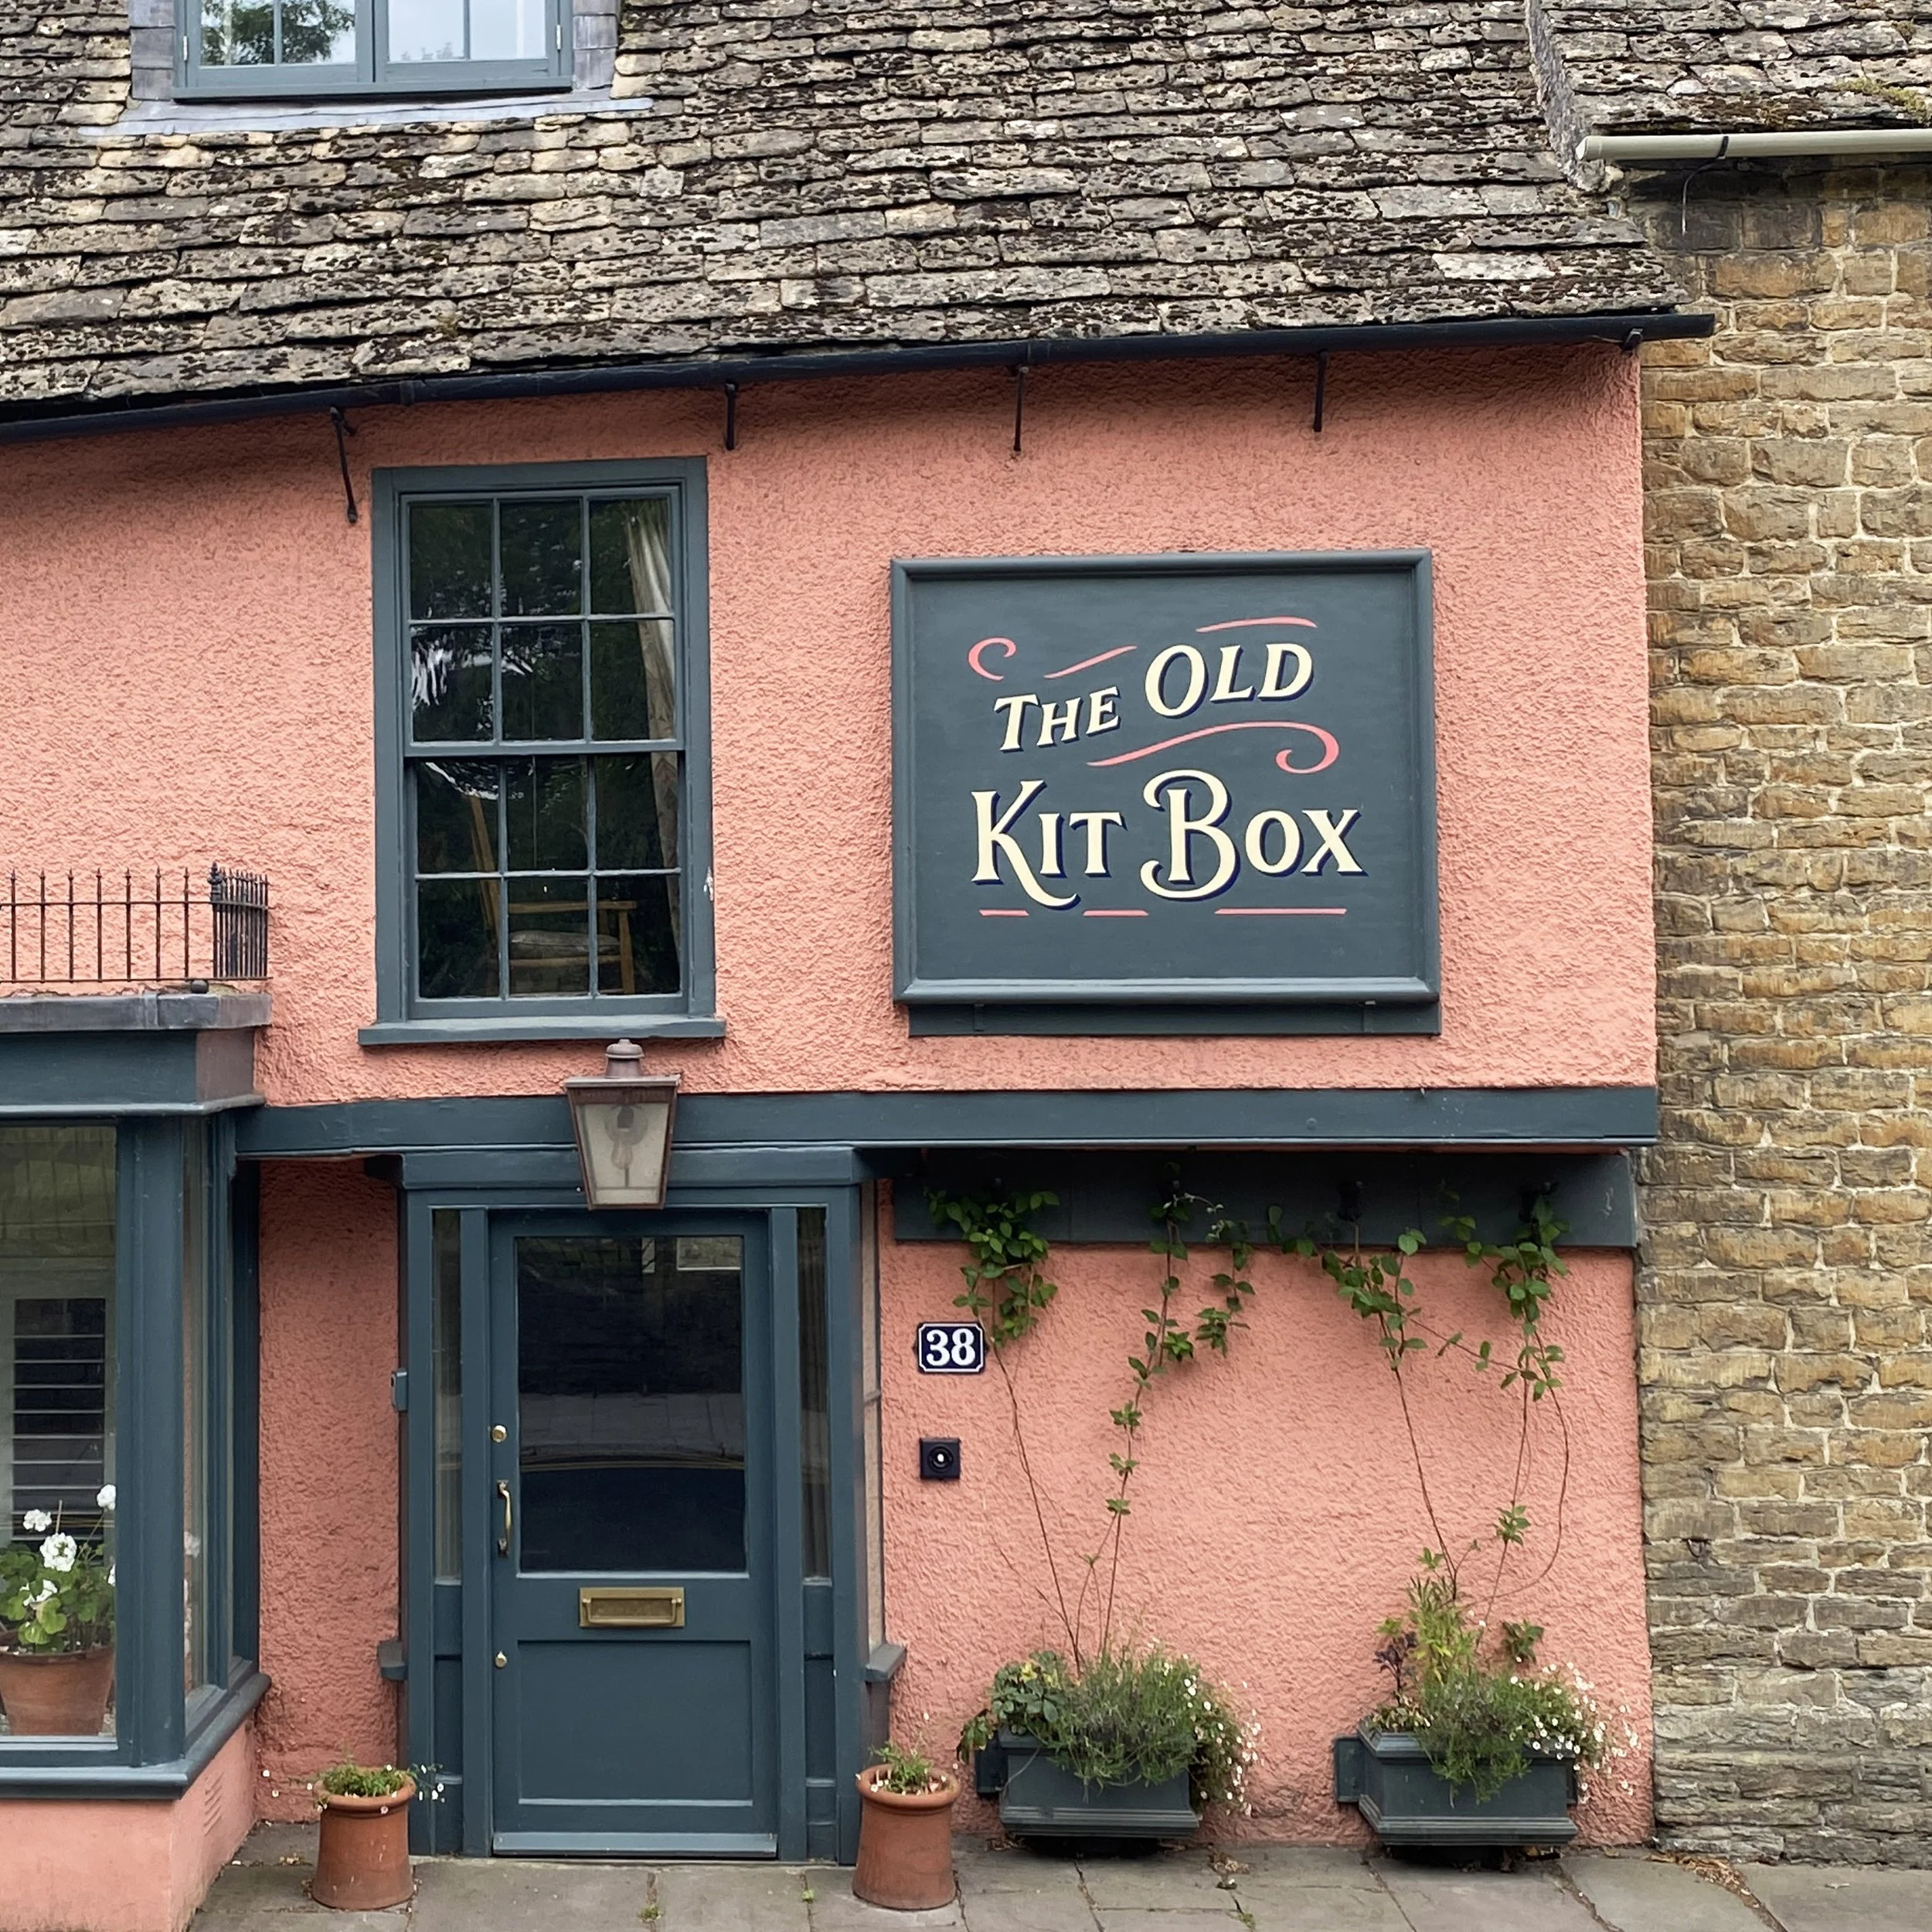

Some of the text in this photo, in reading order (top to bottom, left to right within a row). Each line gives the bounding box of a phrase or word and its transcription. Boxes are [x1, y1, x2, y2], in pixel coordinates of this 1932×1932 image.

[993, 643, 1315, 751] THE OLD
[971, 770, 1368, 910] KIT BOX
[926, 1328, 976, 1366] 38
